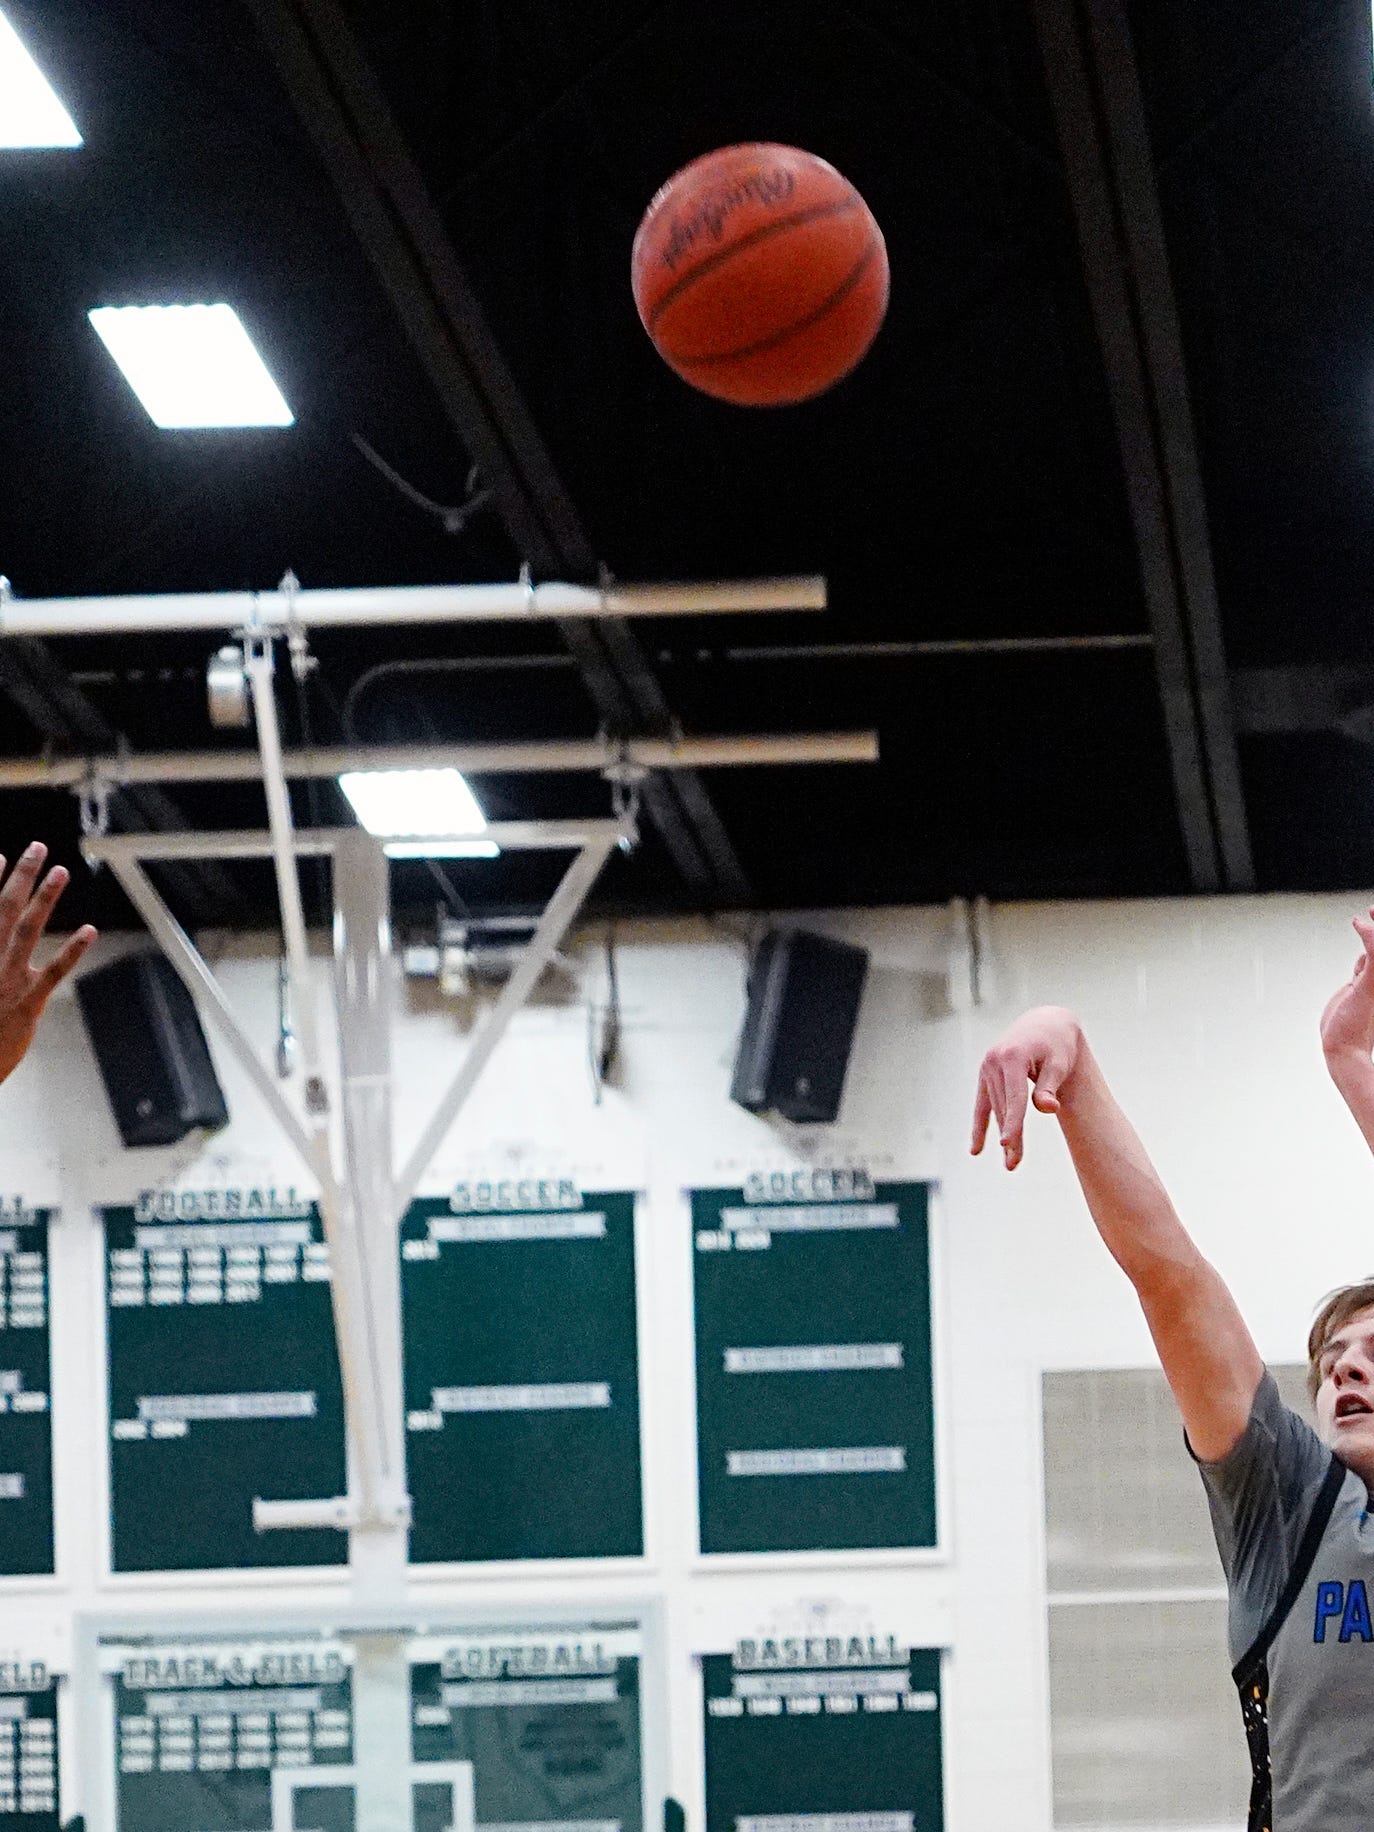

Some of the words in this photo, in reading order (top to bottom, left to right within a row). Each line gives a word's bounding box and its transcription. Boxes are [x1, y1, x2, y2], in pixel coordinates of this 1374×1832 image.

[450, 1180, 583, 1212] SOCCER
[744, 1168, 876, 1203] SOCCER
[135, 1187, 311, 1221] FOOTBALL
[441, 1643, 618, 1679] SOFTBALL
[732, 1634, 911, 1669] BASEBALL
[122, 1656, 224, 1689] TRACK
[254, 1650, 348, 1684] FIELD
